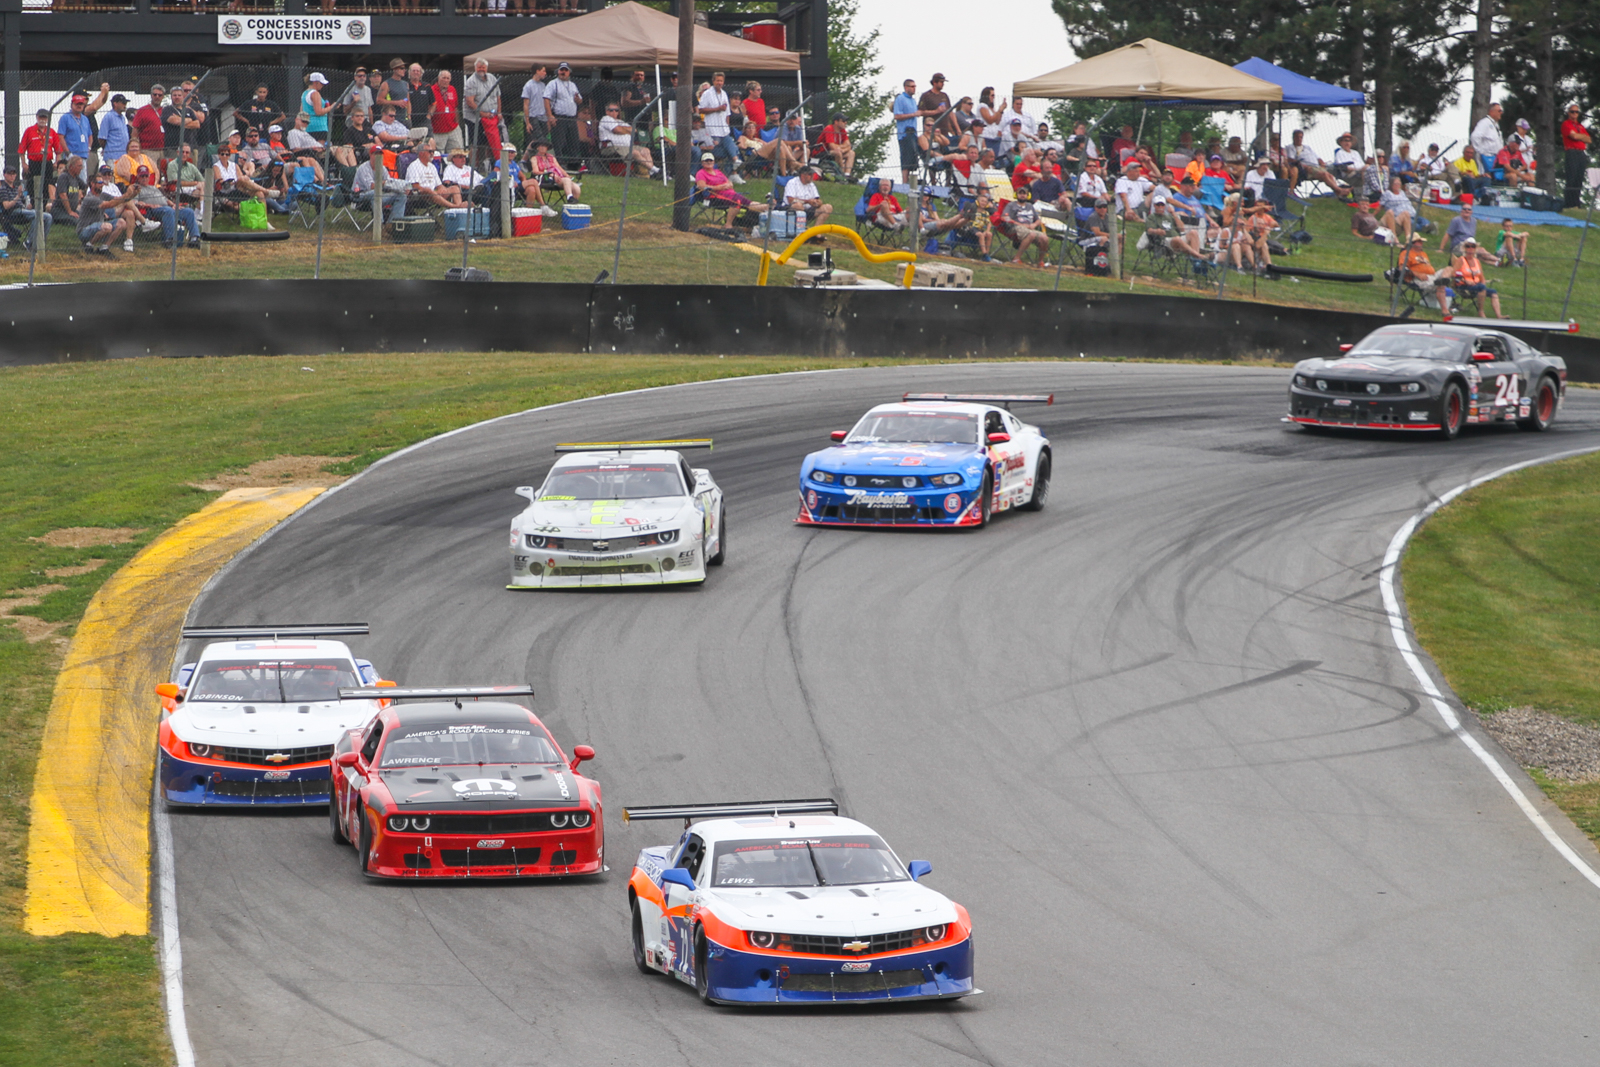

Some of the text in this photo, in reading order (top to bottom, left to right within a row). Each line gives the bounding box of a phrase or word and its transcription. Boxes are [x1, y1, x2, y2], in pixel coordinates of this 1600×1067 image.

[247, 19, 342, 30] CONCESSIONS
[256, 30, 333, 40] SOUVENIRS
[1495, 373, 1520, 407] 24
[900, 457, 924, 466] 5
[844, 488, 909, 508] Raybestos
[631, 524, 658, 533] Lids
[191, 694, 244, 702] ROBINSON
[404, 729, 447, 739] AMERICA'S
[381, 757, 442, 767] LAWRENCE
[734, 844, 780, 853] AMERICA'S
[720, 877, 755, 885] LEWIS
